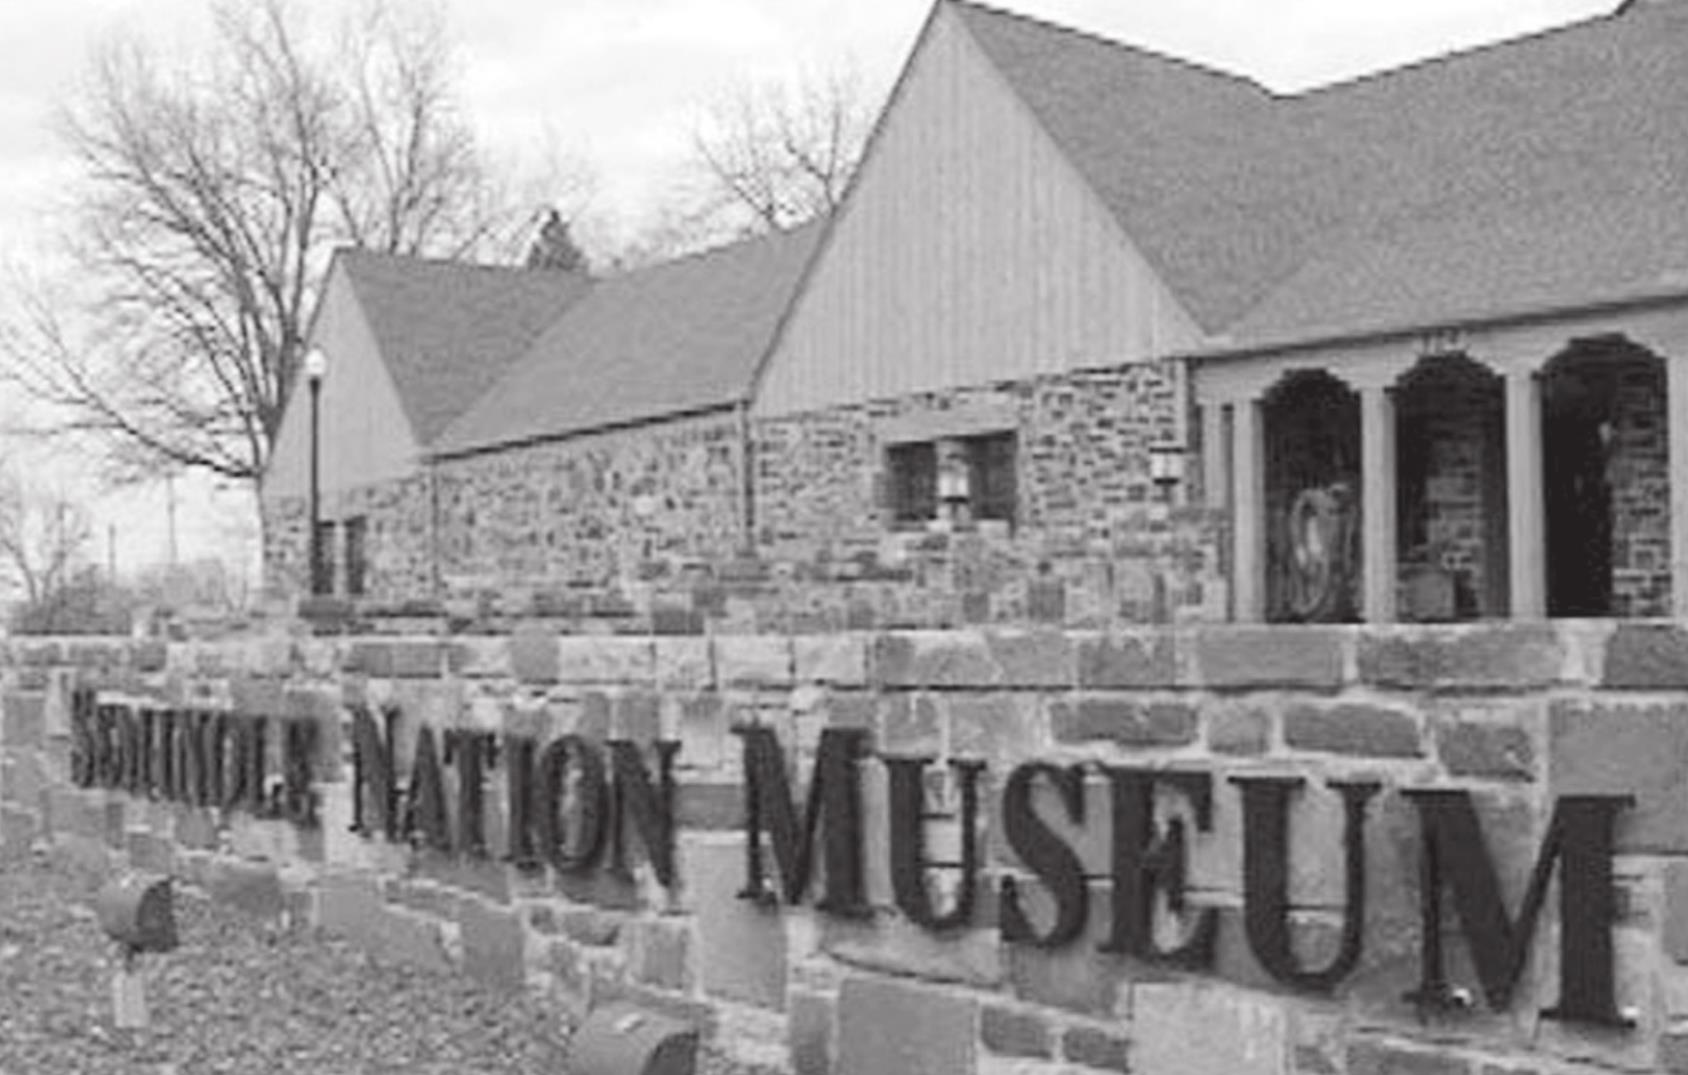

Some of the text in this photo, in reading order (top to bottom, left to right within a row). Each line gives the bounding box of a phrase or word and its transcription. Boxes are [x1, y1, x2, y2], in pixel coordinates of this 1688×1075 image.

[70, 689, 1638, 1028] SEMINOLE NATION MUSEUM
